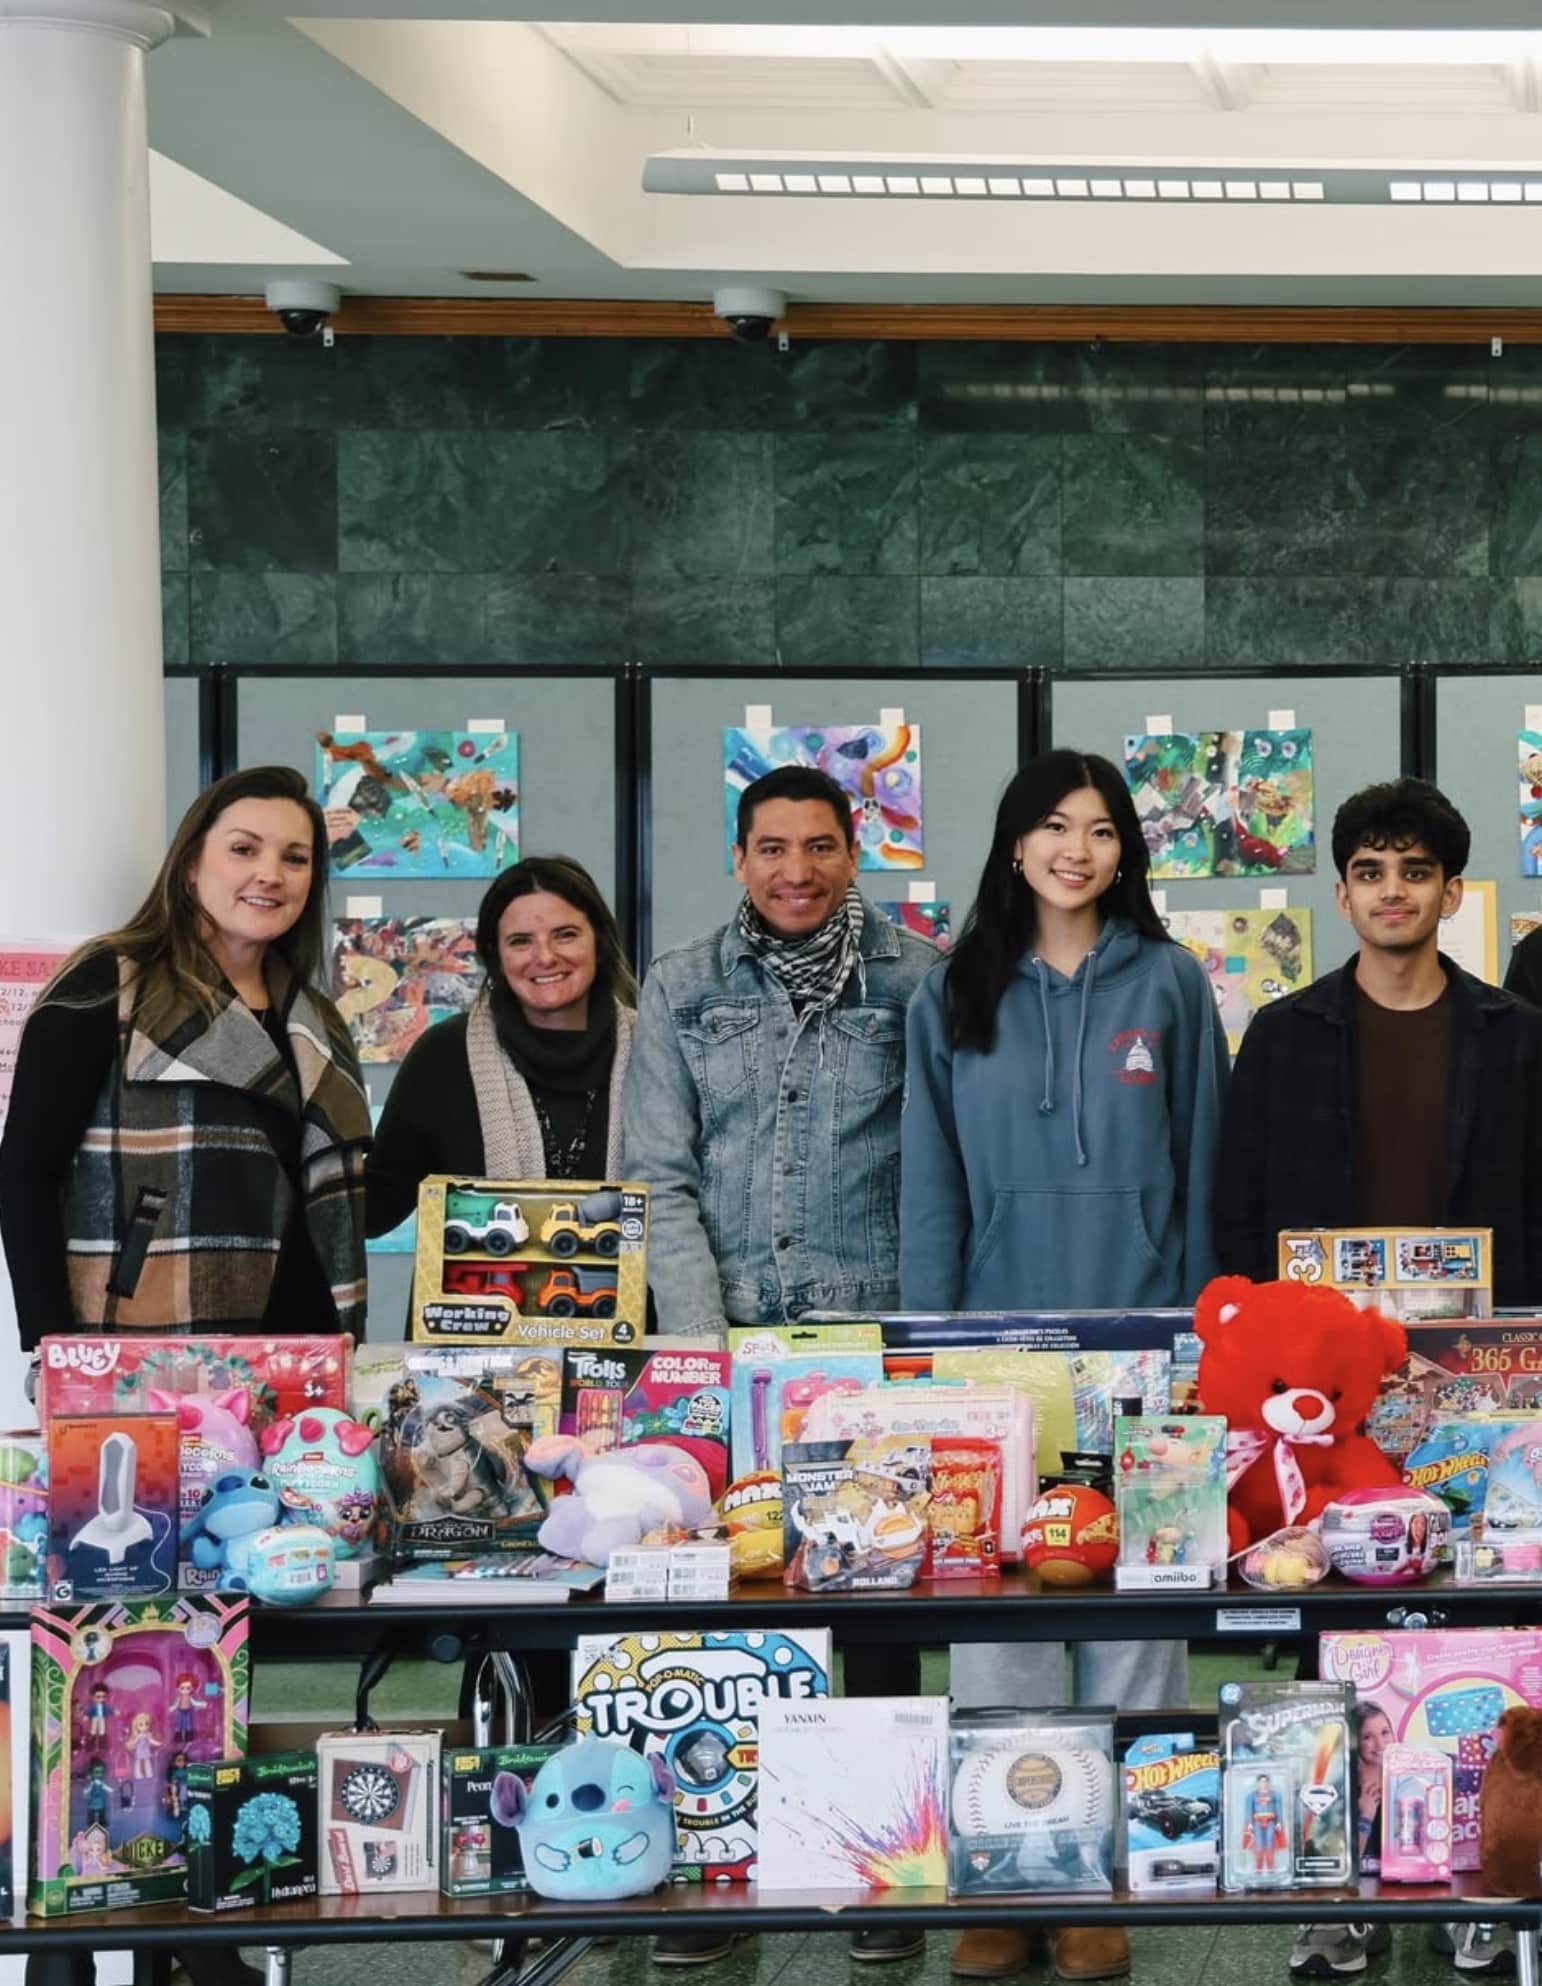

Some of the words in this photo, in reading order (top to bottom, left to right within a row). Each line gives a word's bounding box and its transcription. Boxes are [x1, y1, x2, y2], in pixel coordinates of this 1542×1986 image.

[423, 1306, 510, 1322] Working
[439, 1321, 490, 1331] Crew
[517, 1325, 575, 1338] Vehicle
[579, 1325, 605, 1338] Set
[617, 1324, 628, 1334] 4
[1502, 1332, 1537, 1343] CLASSIC
[568, 1352, 626, 1379] Trolls
[652, 1357, 707, 1370] COLOR
[1471, 1347, 1511, 1371] 365
[651, 1370, 721, 1384] NUMBER
[786, 1470, 855, 1484] MONSTER
[1409, 1464, 1440, 1488] HOT
[1438, 1453, 1489, 1480] WHEELS
[803, 1481, 836, 1493] JAM
[411, 1525, 489, 1537] DRAGON
[1153, 1572, 1197, 1583] amiibo
[1349, 1660, 1379, 1681] Girl
[645, 1669, 705, 1692] POP-O-MATIC
[587, 1671, 813, 1733] TROUBLE
[1243, 1702, 1346, 1746] SUPERMAN
[1135, 1762, 1172, 1792] HOT
[1168, 1753, 1221, 1785] WHEELS
[466, 1781, 492, 1792] Peon
[682, 1816, 719, 1827] TROUBLE
